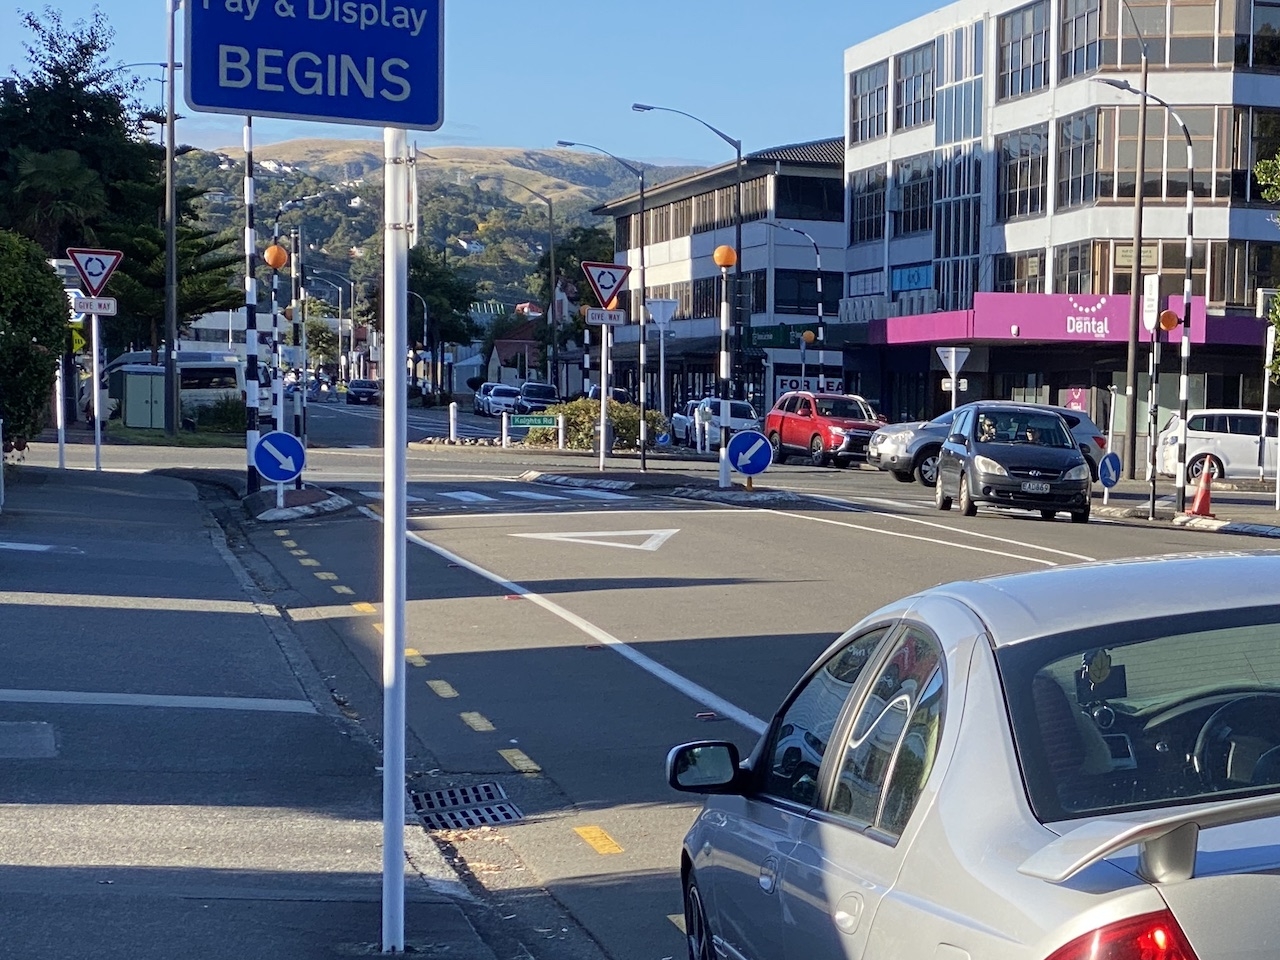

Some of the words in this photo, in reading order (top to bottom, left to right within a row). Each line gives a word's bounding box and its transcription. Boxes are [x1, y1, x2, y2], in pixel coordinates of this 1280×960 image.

[308, 0, 427, 36] Display
[219, 44, 412, 102] BEGINS
[78, 302, 93, 310] GIVE
[98, 302, 111, 310] WAY
[591, 312, 604, 321] GIVE
[608, 313, 621, 321] WAY
[1066, 316, 1110, 334] Dental
[780, 379, 810, 390] FOR
[514, 417, 541, 426] Knights
[542, 417, 553, 425] Rd
